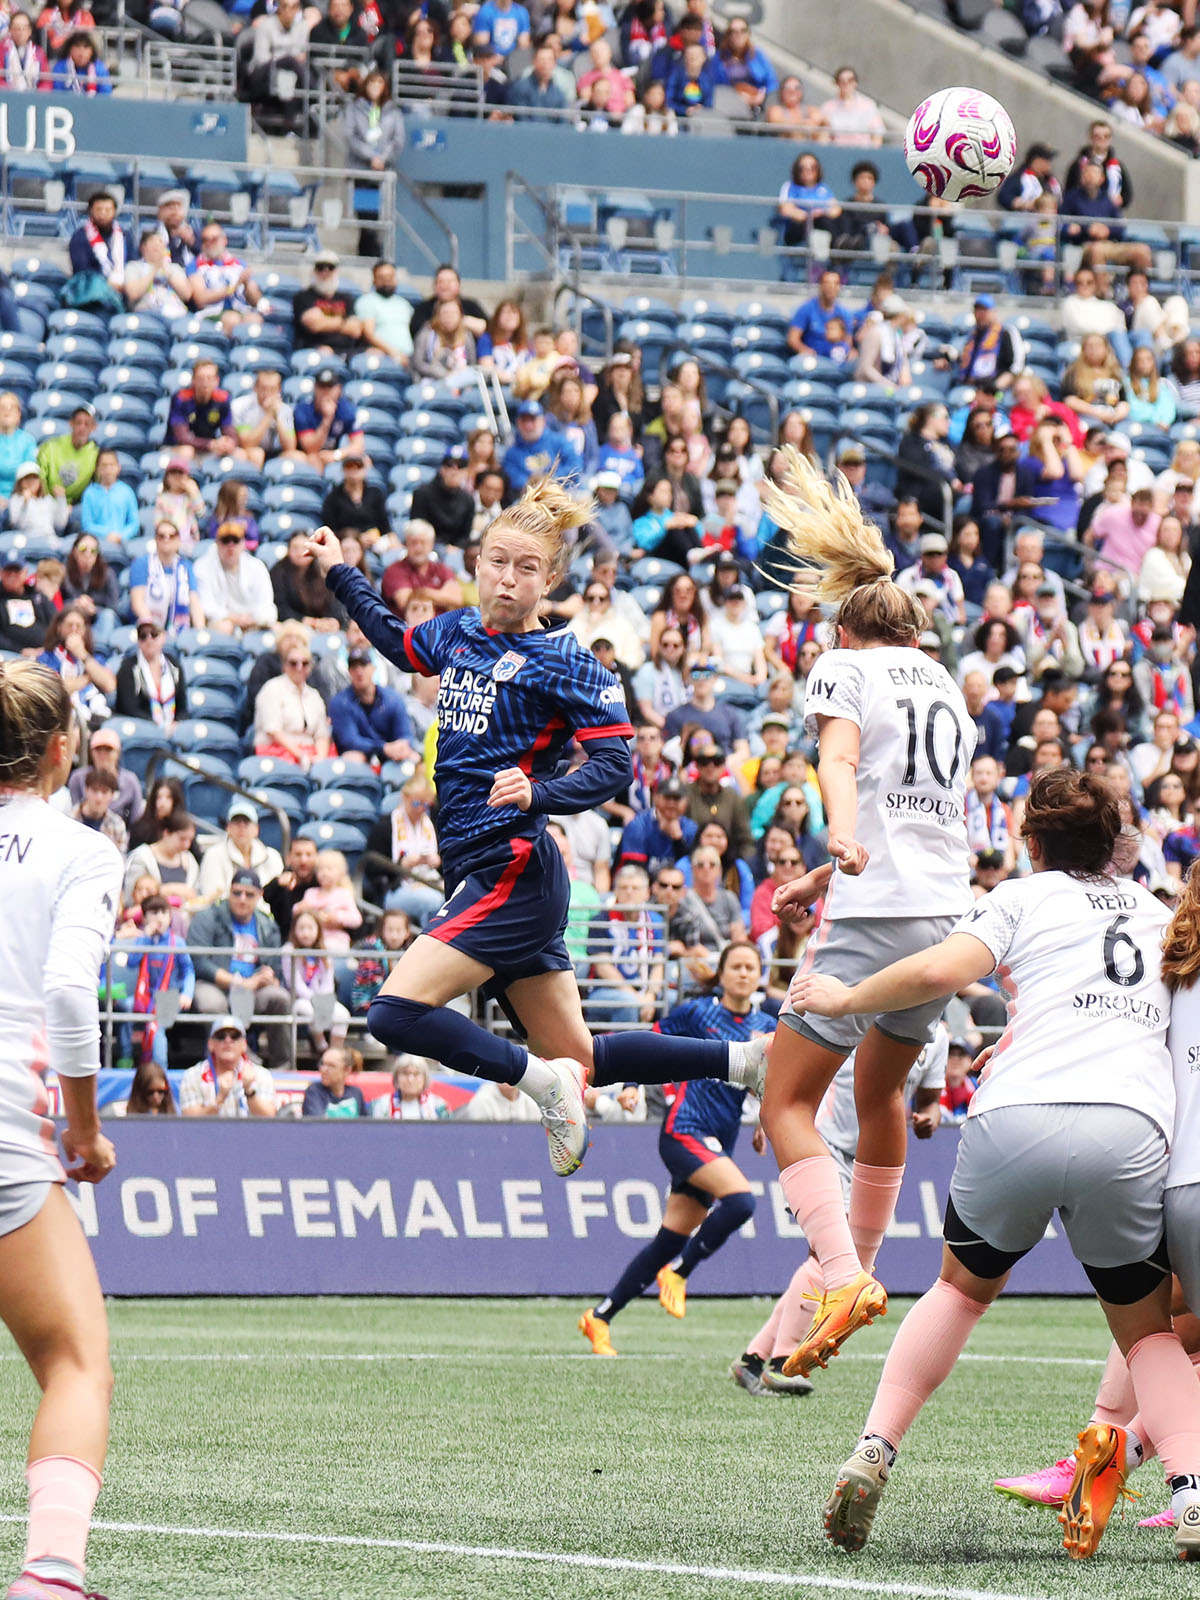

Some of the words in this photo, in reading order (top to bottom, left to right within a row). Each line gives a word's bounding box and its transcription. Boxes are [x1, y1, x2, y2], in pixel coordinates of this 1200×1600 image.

[440, 666, 498, 696] BLACK
[806, 678, 837, 702] lly
[437, 688, 496, 715] FUTURE
[443, 709, 489, 735] FUND
[896, 698, 962, 790] 10
[885, 792, 959, 819] SPROUTS
[436, 878, 467, 918] 2
[1085, 892, 1137, 911] REID
[1102, 912, 1147, 987] 6
[1073, 992, 1161, 1024] SPROUTS
[1121, 1011, 1158, 1031] MARKET
[120, 1177, 219, 1238] OF
[241, 1178, 549, 1239] FEMALE
